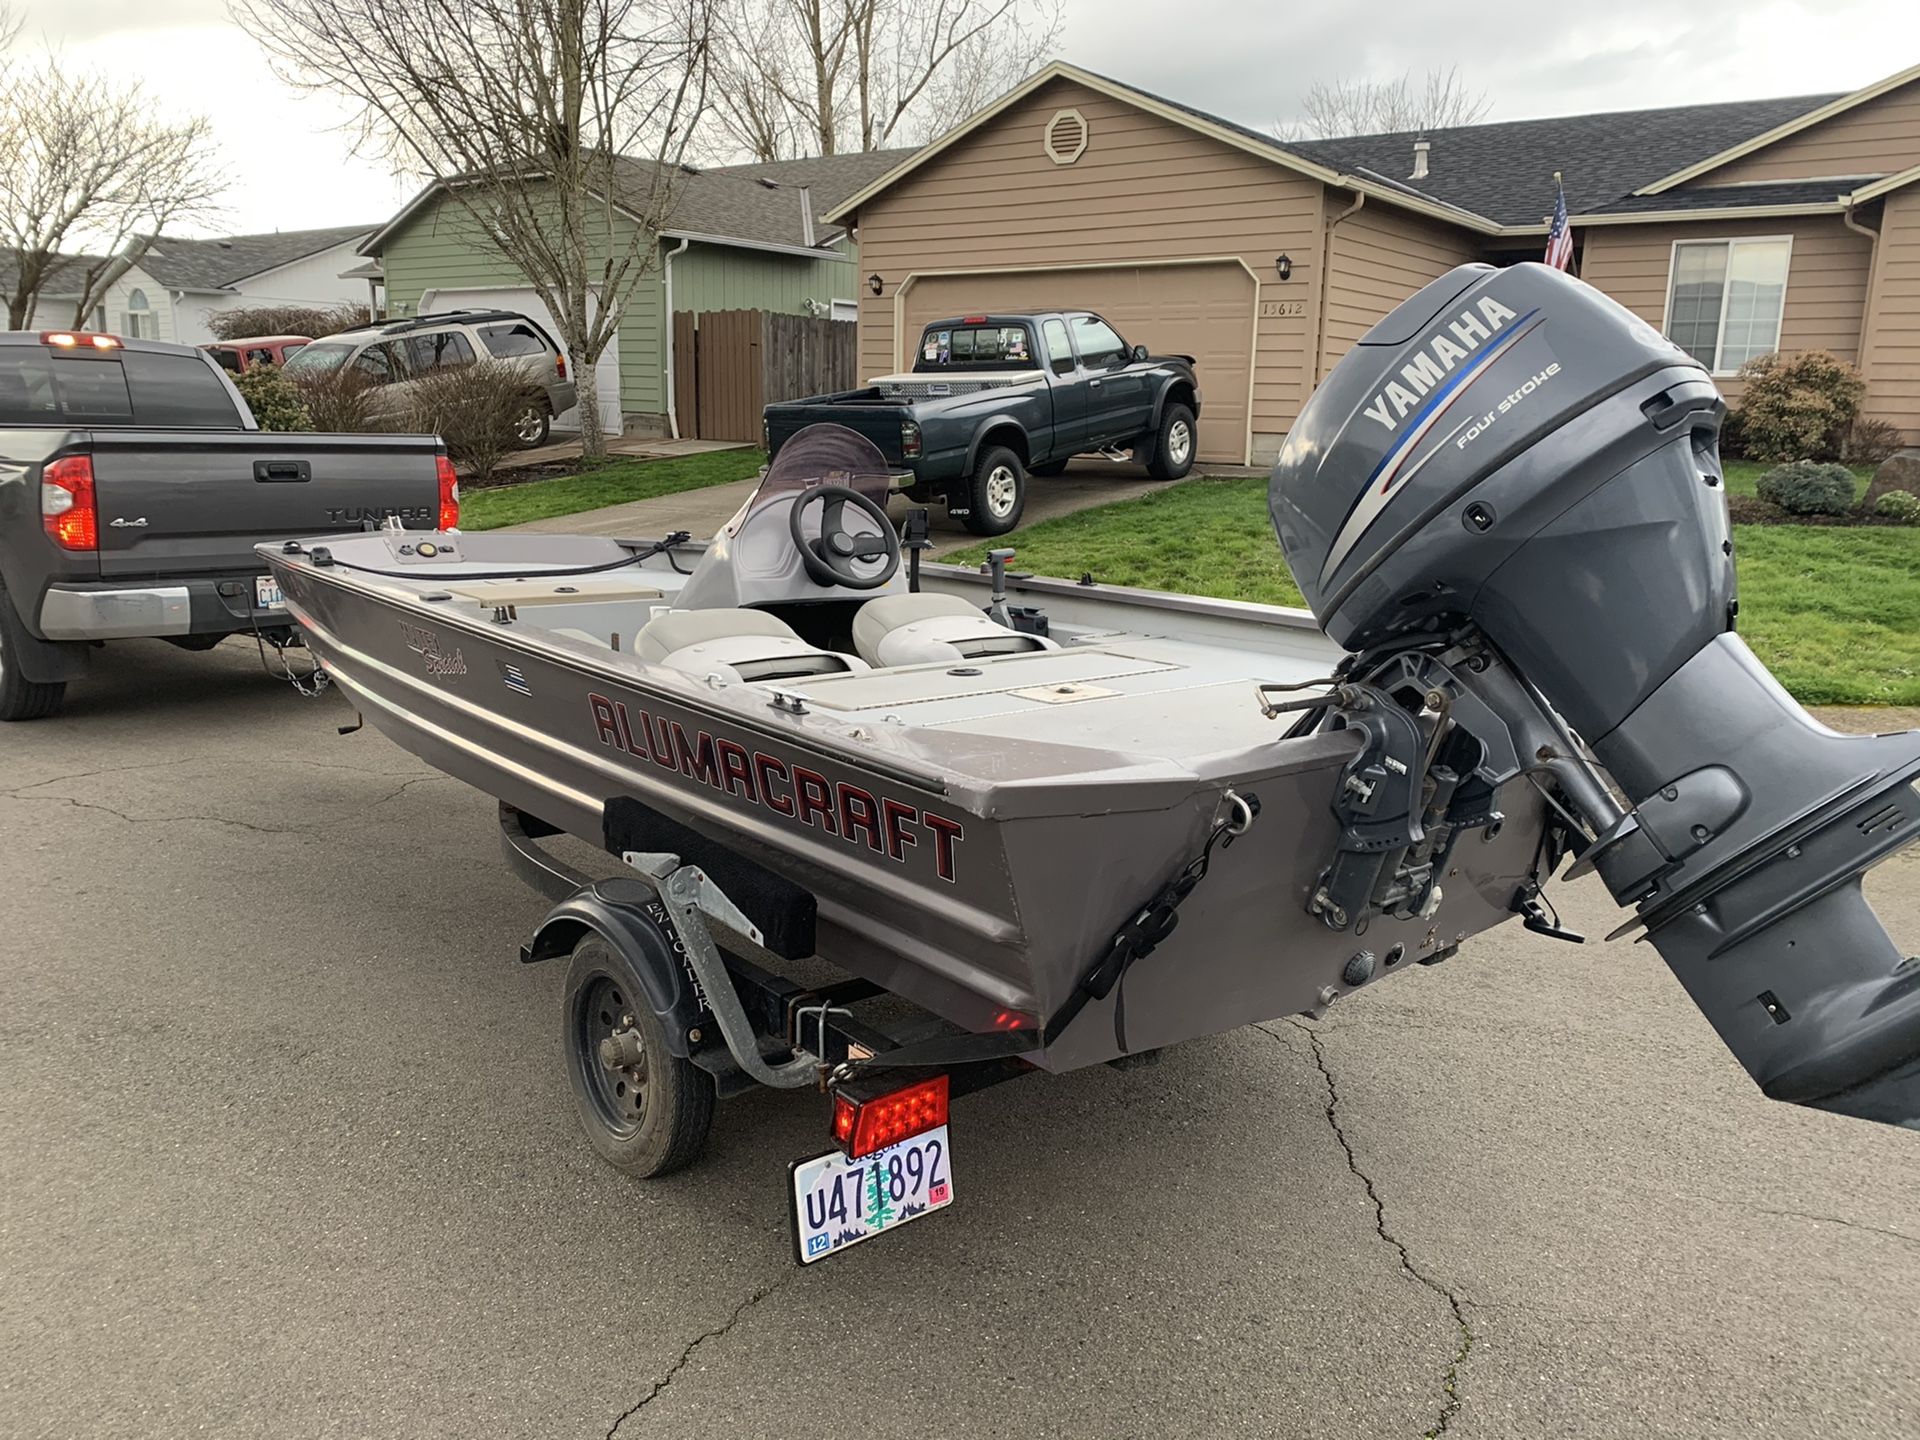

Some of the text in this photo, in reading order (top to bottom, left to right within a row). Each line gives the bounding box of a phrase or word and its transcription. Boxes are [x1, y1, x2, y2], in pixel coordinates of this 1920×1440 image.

[1263, 303, 1303, 316] 15612
[1363, 295, 1518, 432] YAMAHA
[324, 505, 432, 523] TUNDRA
[588, 692, 964, 884] ALUMACRAFT
[806, 1139, 946, 1230] U471892
[934, 1187, 945, 1197] 19
[810, 1237, 827, 1253] 12
